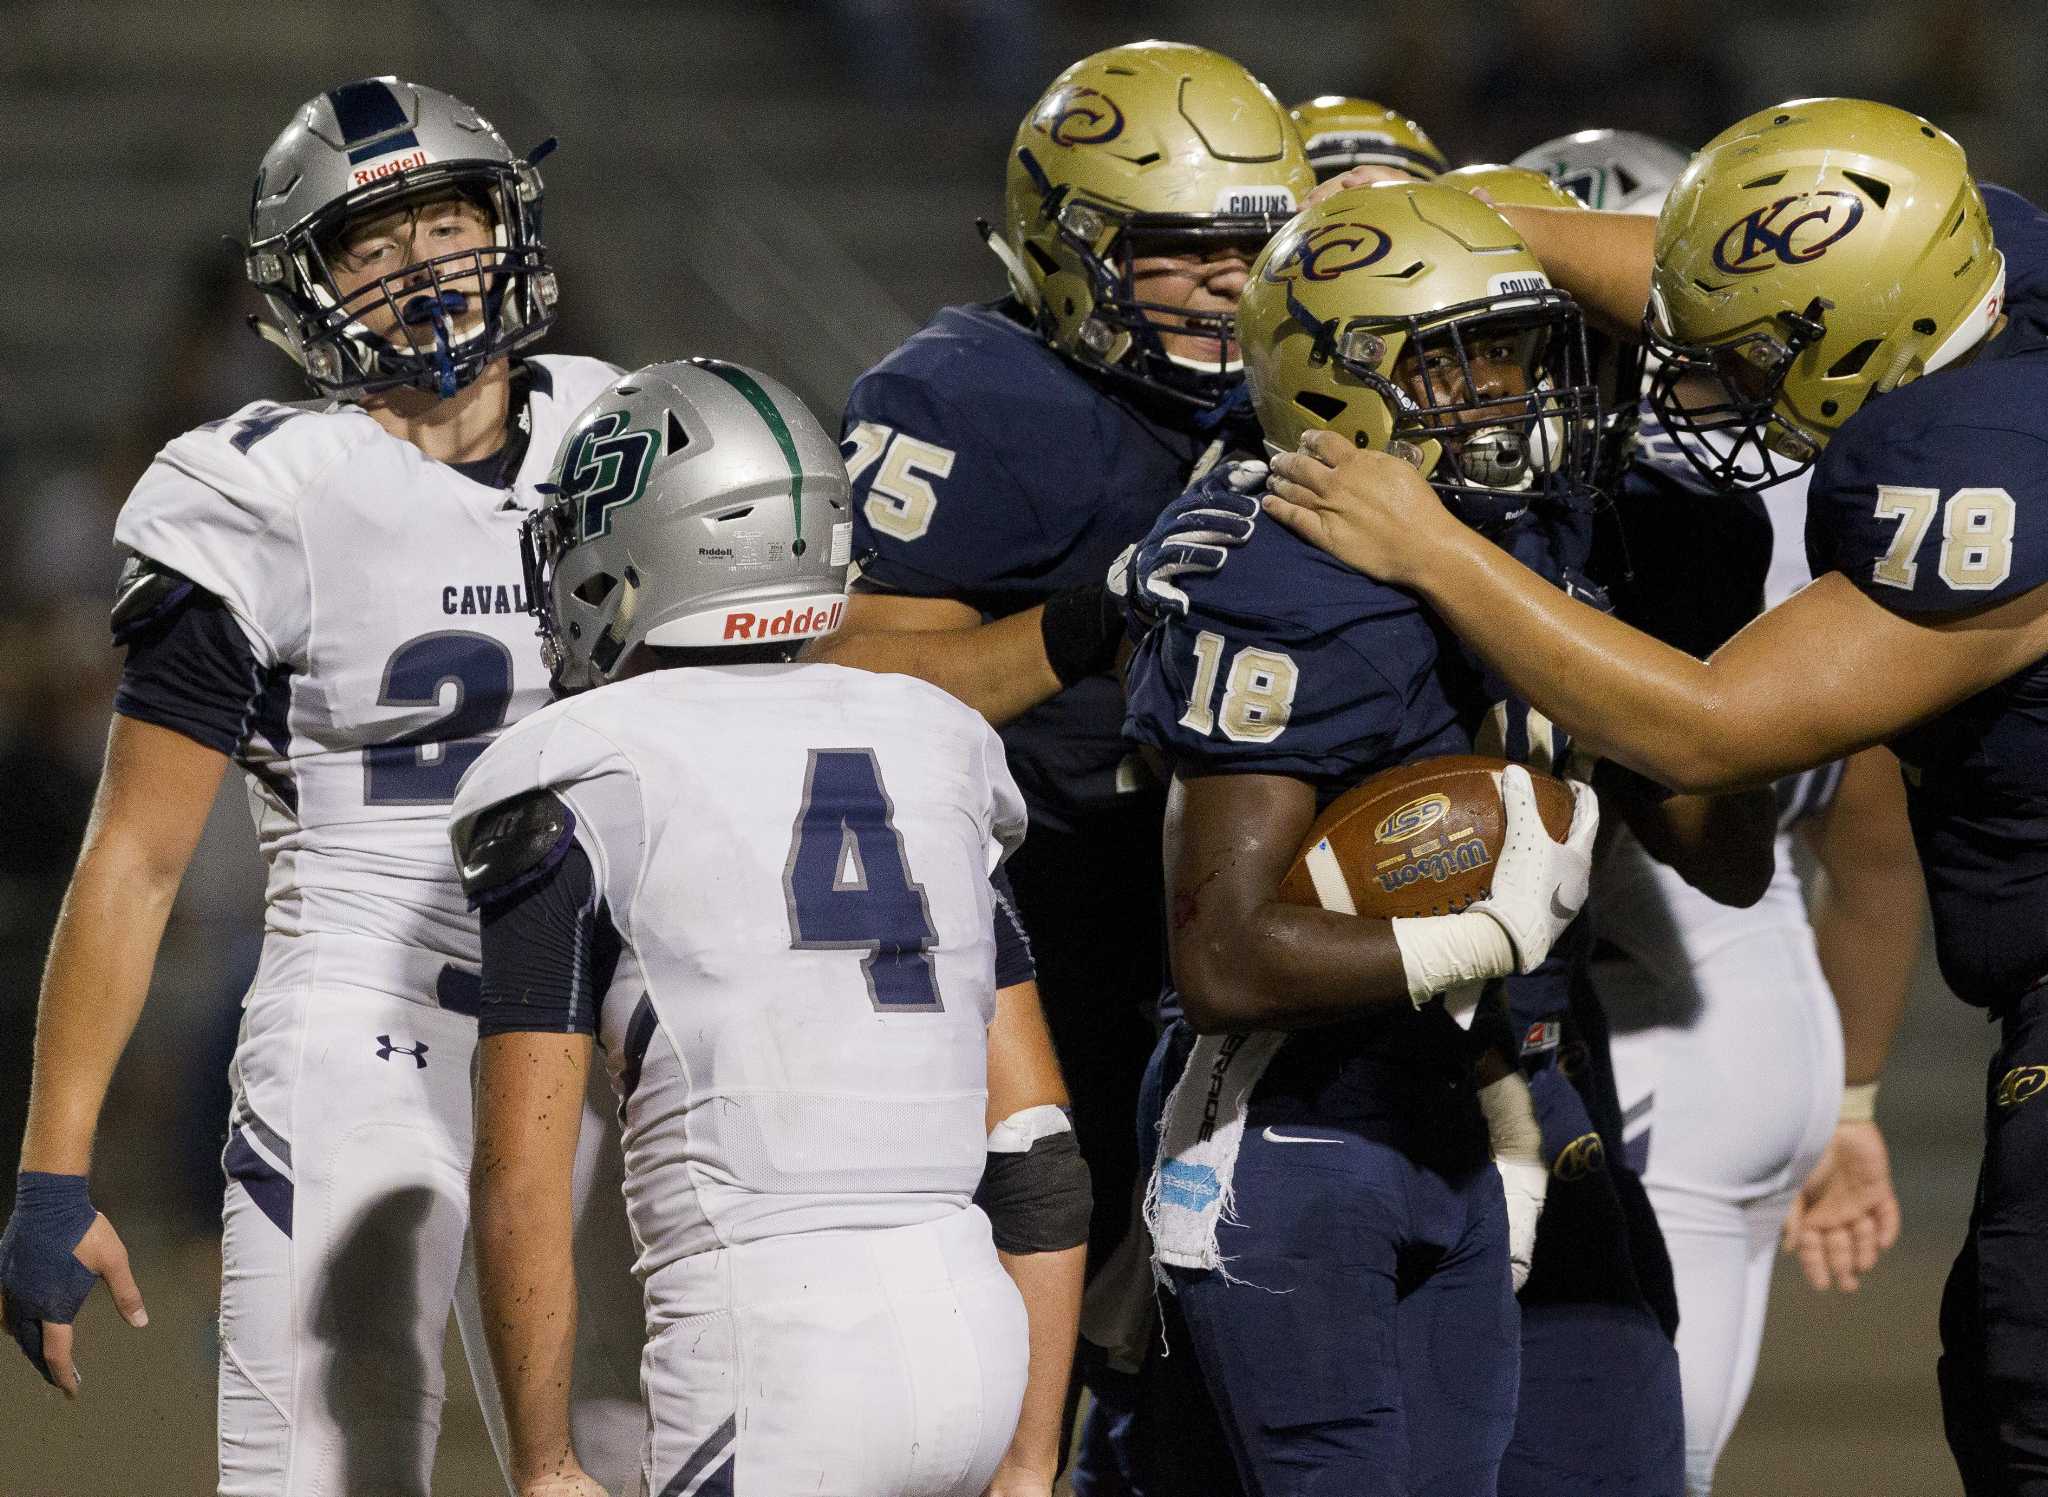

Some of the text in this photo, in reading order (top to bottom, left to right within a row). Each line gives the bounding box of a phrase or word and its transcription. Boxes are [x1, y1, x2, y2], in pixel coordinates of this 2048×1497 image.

[354, 151, 426, 185] Riddell
[1230, 194, 1288, 214] COLLINS
[1712, 191, 1864, 274] KC
[556, 410, 662, 543] CP
[840, 421, 956, 542] 75
[699, 547, 733, 557] Riddell
[1873, 485, 2016, 591] 78
[442, 584, 528, 615] CAVAL
[723, 601, 843, 640] Riddell
[362, 629, 514, 806] 2
[1178, 630, 1299, 743] 18
[1381, 799, 1444, 838] GST
[783, 748, 944, 1013] 4
[1374, 838, 1492, 893] Wilson
[1198, 1034, 1246, 1143] ERADE
